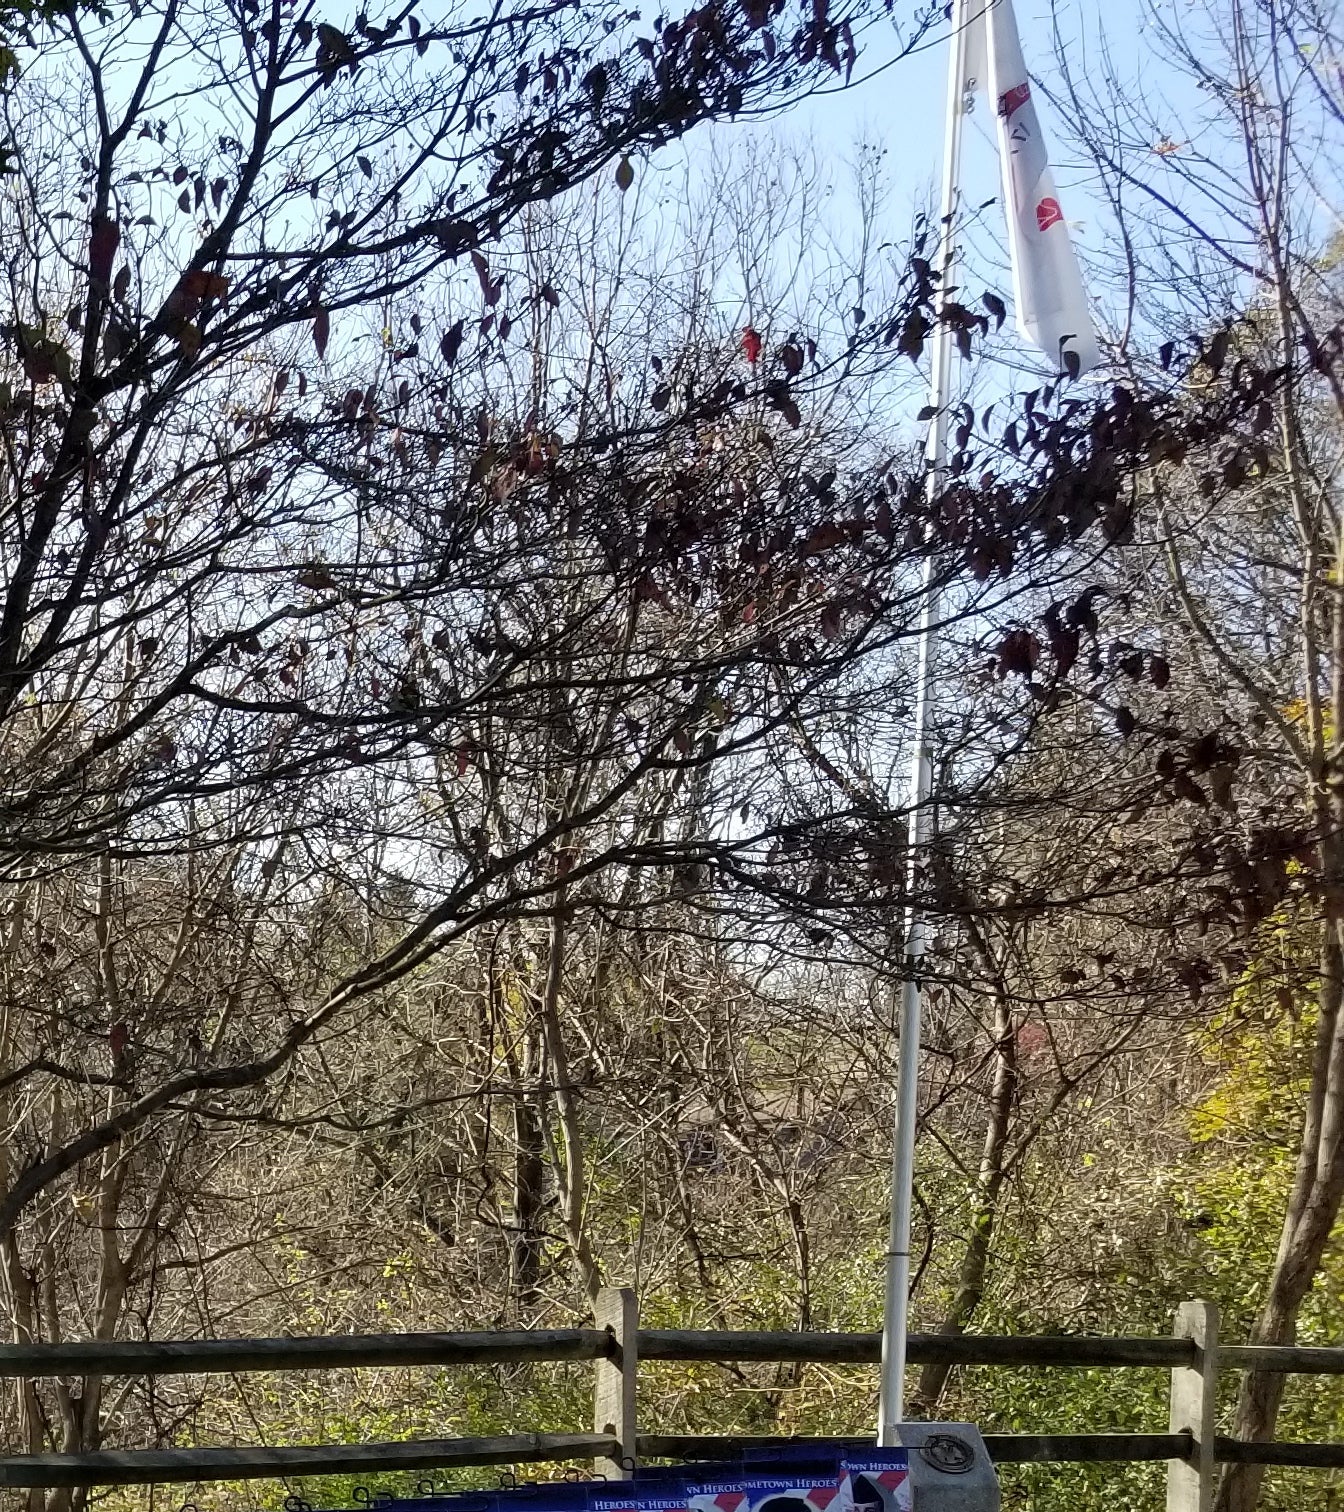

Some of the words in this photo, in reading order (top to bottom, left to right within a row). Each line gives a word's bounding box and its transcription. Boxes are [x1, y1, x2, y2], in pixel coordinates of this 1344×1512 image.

[869, 1462, 907, 1471] HEROES
[703, 1483, 742, 1494] HEROES
[744, 1479, 793, 1489] METOWN
[796, 1478, 838, 1488] HEROES
[595, 1500, 634, 1510] HEROES
[648, 1500, 686, 1510] HEROES
